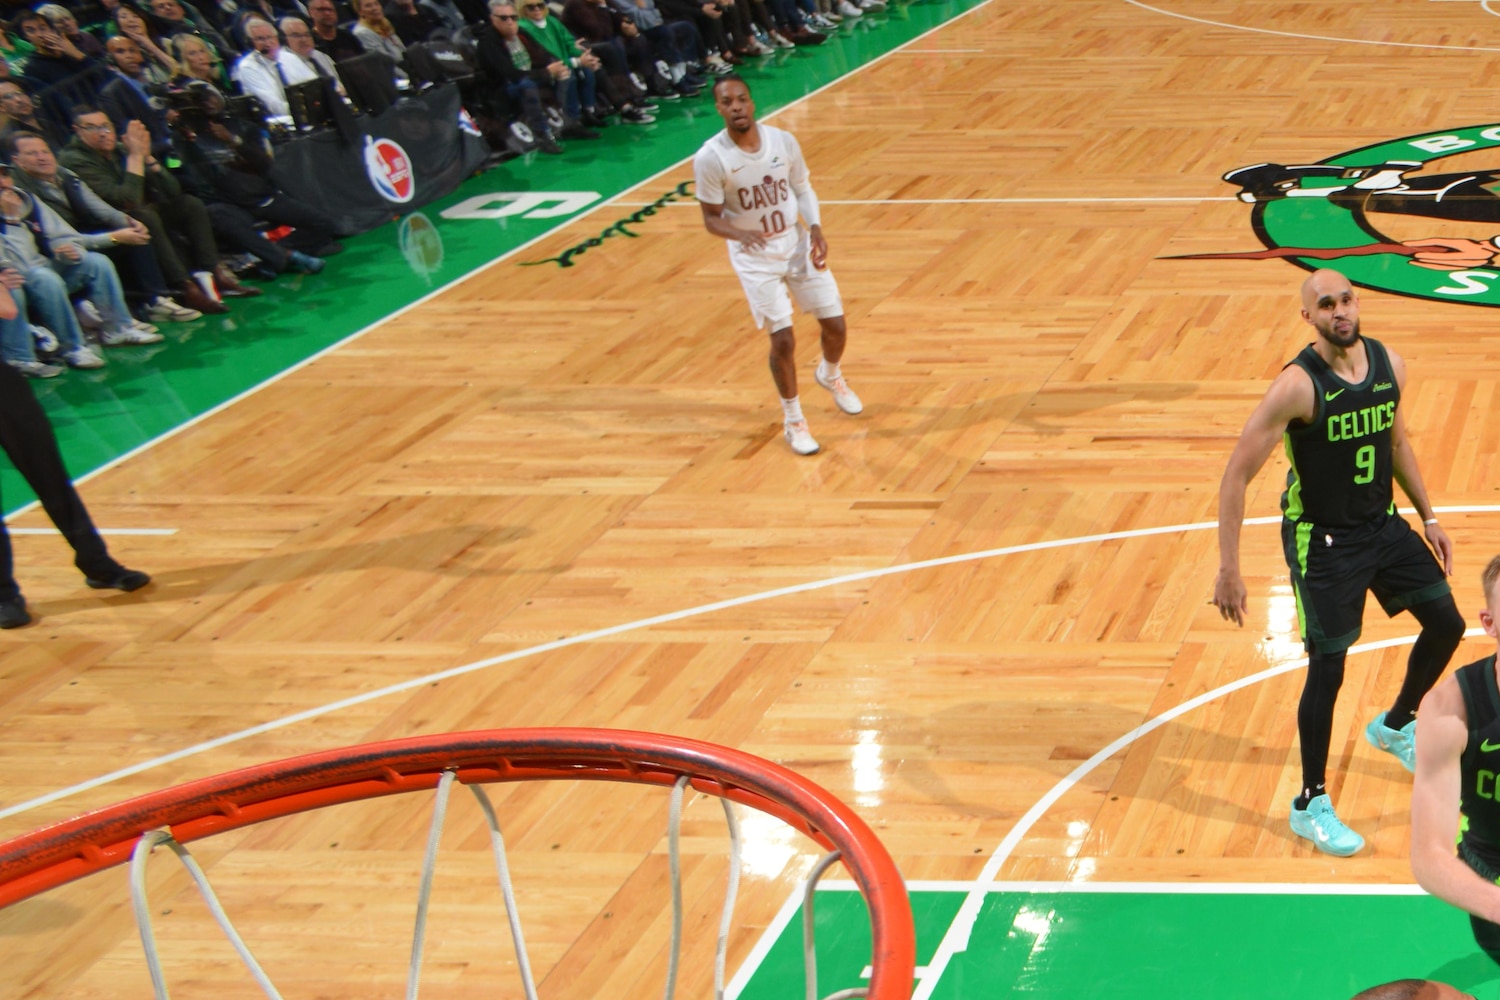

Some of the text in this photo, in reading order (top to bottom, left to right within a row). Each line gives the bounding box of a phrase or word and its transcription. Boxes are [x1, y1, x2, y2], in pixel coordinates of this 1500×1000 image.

[737, 177, 789, 211] CAVS
[759, 210, 787, 234] 10
[1327, 400, 1395, 442] CELTICS
[1354, 445, 1376, 485] 9
